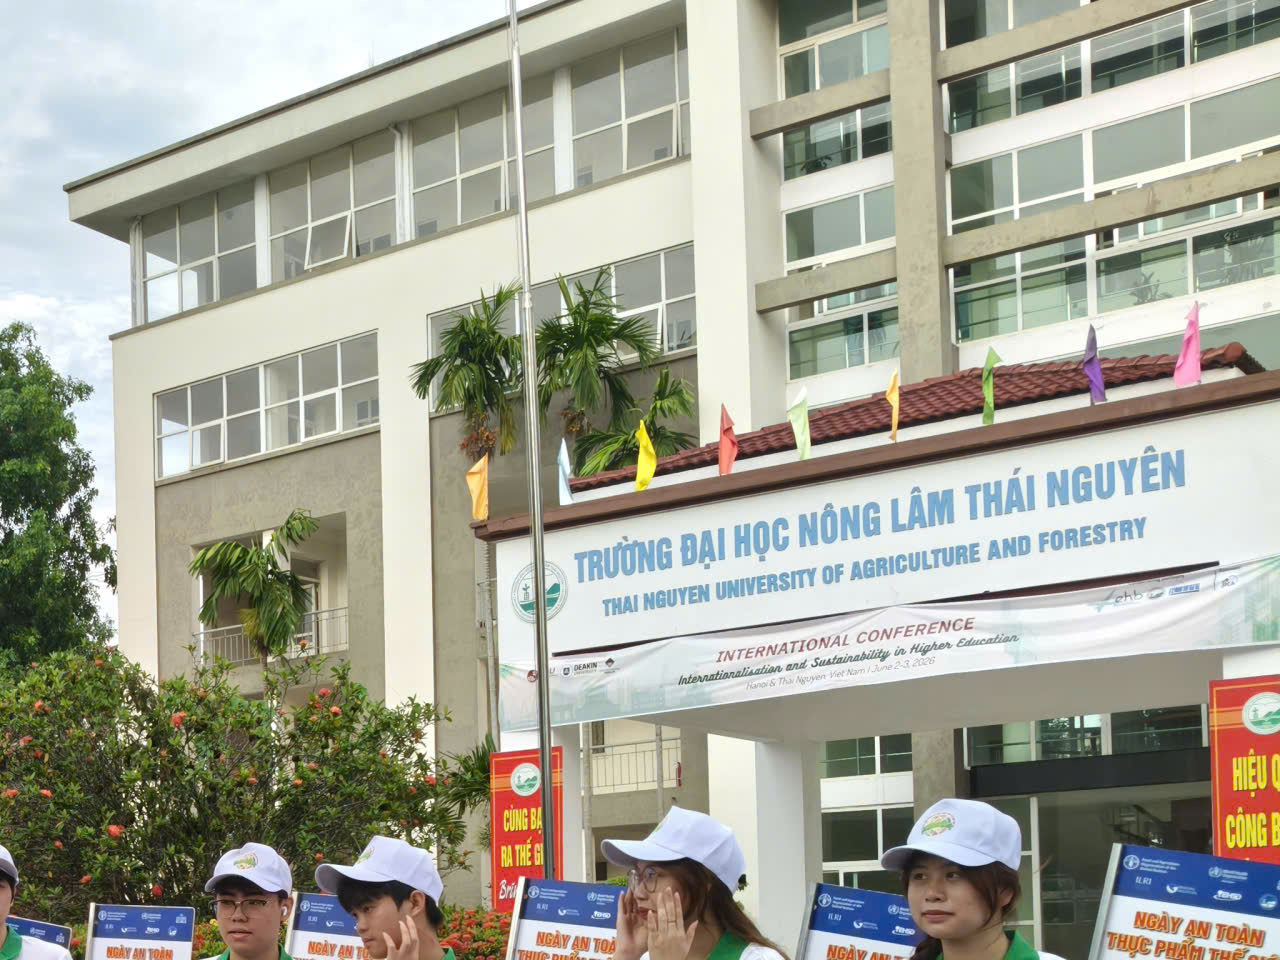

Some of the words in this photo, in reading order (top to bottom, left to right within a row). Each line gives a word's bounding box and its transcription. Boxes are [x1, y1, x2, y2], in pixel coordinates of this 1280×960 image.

[574, 535, 672, 584] TRƯỜNG
[680, 526, 725, 570] ĐẠI
[734, 517, 789, 562] HỌC
[798, 502, 881, 548] NÔNG
[891, 486, 954, 533] LÂM
[964, 467, 1035, 521] THÁI
[1046, 445, 1186, 507] NGUYÊN
[602, 592, 638, 617] THAI
[643, 583, 710, 612] NGUYEN
[716, 567, 817, 601] UNIVERSITY
[822, 563, 845, 585] OF
[850, 542, 980, 581] AGRICULTURE
[988, 534, 1031, 561] AND
[1038, 516, 1147, 553] FORESTRY
[716, 633, 850, 663] INTERNATIONAL
[856, 617, 976, 645] CONFERENCE
[574, 662, 598, 671] DEAKIN
[678, 663, 783, 686] Internationalisation
[786, 658, 808, 672] and
[810, 647, 891, 670] Sustainability
[894, 645, 907, 657] in
[910, 640, 953, 658] Higher
[956, 633, 1020, 648] Education
[1232, 748, 1268, 797] HIỆU
[503, 806, 529, 832] CÙNG
[530, 807, 543, 834] BẠ
[1225, 807, 1268, 849] CÔNG
[500, 845, 513, 868] RA
[515, 836, 532, 866] THẾ
[536, 930, 571, 949] NGÀY
[571, 936, 591, 952] AN
[593, 936, 617, 953] TOÀ
[1107, 931, 1152, 958] THỰC
[1134, 911, 1183, 934] NGÀY
[1184, 919, 1211, 939] AN
[1215, 923, 1266, 948] TOÀN
[106, 944, 132, 959] NGÀY
[133, 948, 147, 960] AN
[307, 940, 338, 957] NGÀY
[337, 945, 354, 960] AN
